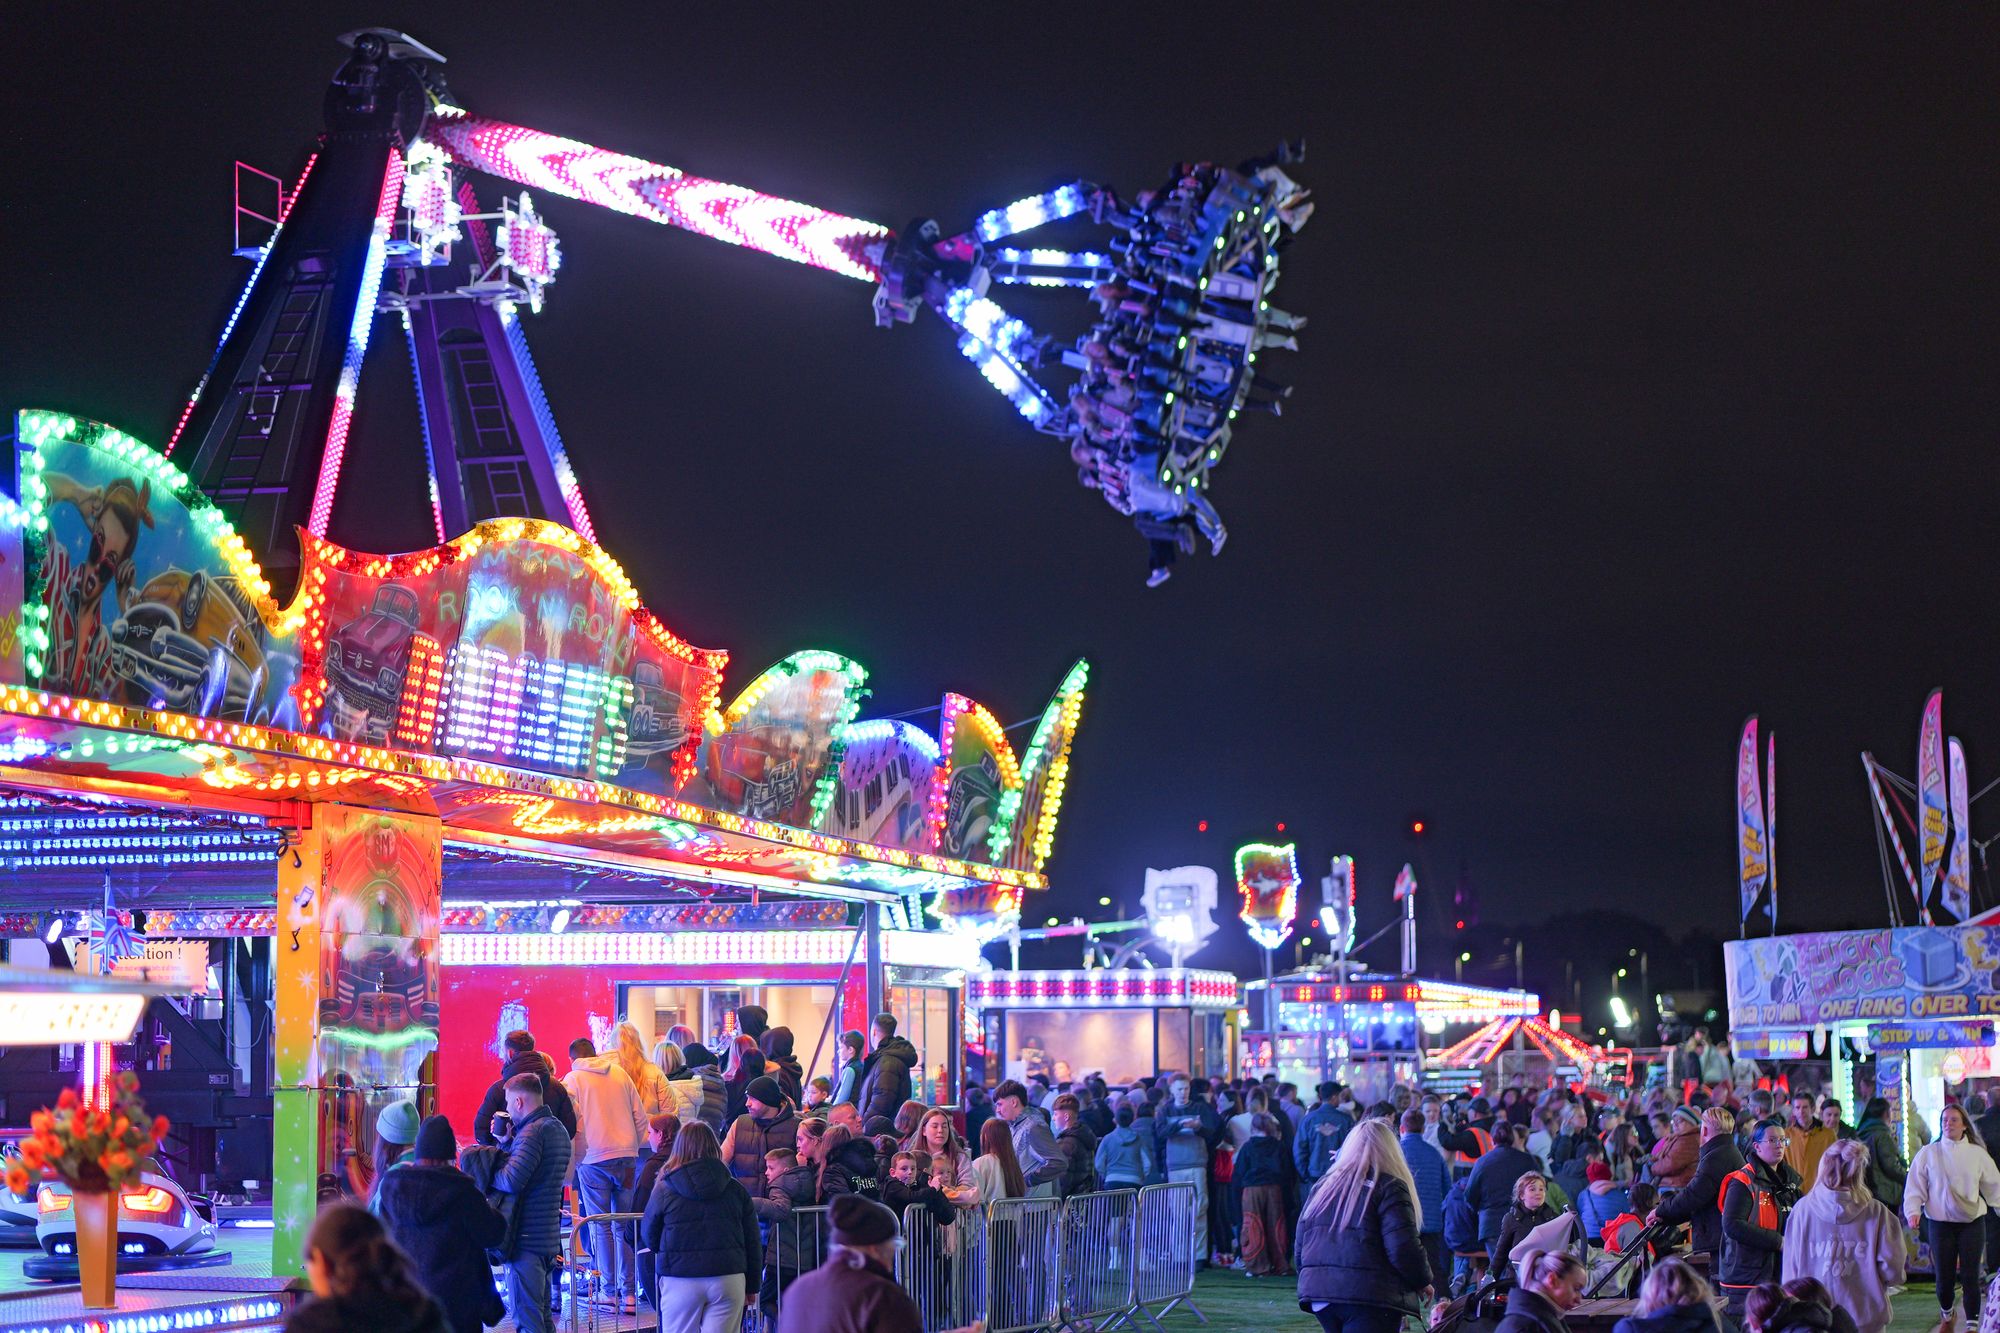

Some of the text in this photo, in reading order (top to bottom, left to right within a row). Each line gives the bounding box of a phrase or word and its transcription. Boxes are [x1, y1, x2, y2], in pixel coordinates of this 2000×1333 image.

[1809, 930, 1892, 972] LUCKY
[1811, 957, 1905, 1000] BLOCKS
[1819, 999, 1856, 1019] ONE
[1859, 995, 1906, 1016] RING
[1911, 994, 1969, 1017] OVER
[1881, 1027, 1913, 1045] STEP
[1915, 1028, 1935, 1043] UP
[1937, 1027, 1949, 1041] &
[1808, 1240, 1868, 1259] WHITE
[1821, 1260, 1857, 1278] FOX
